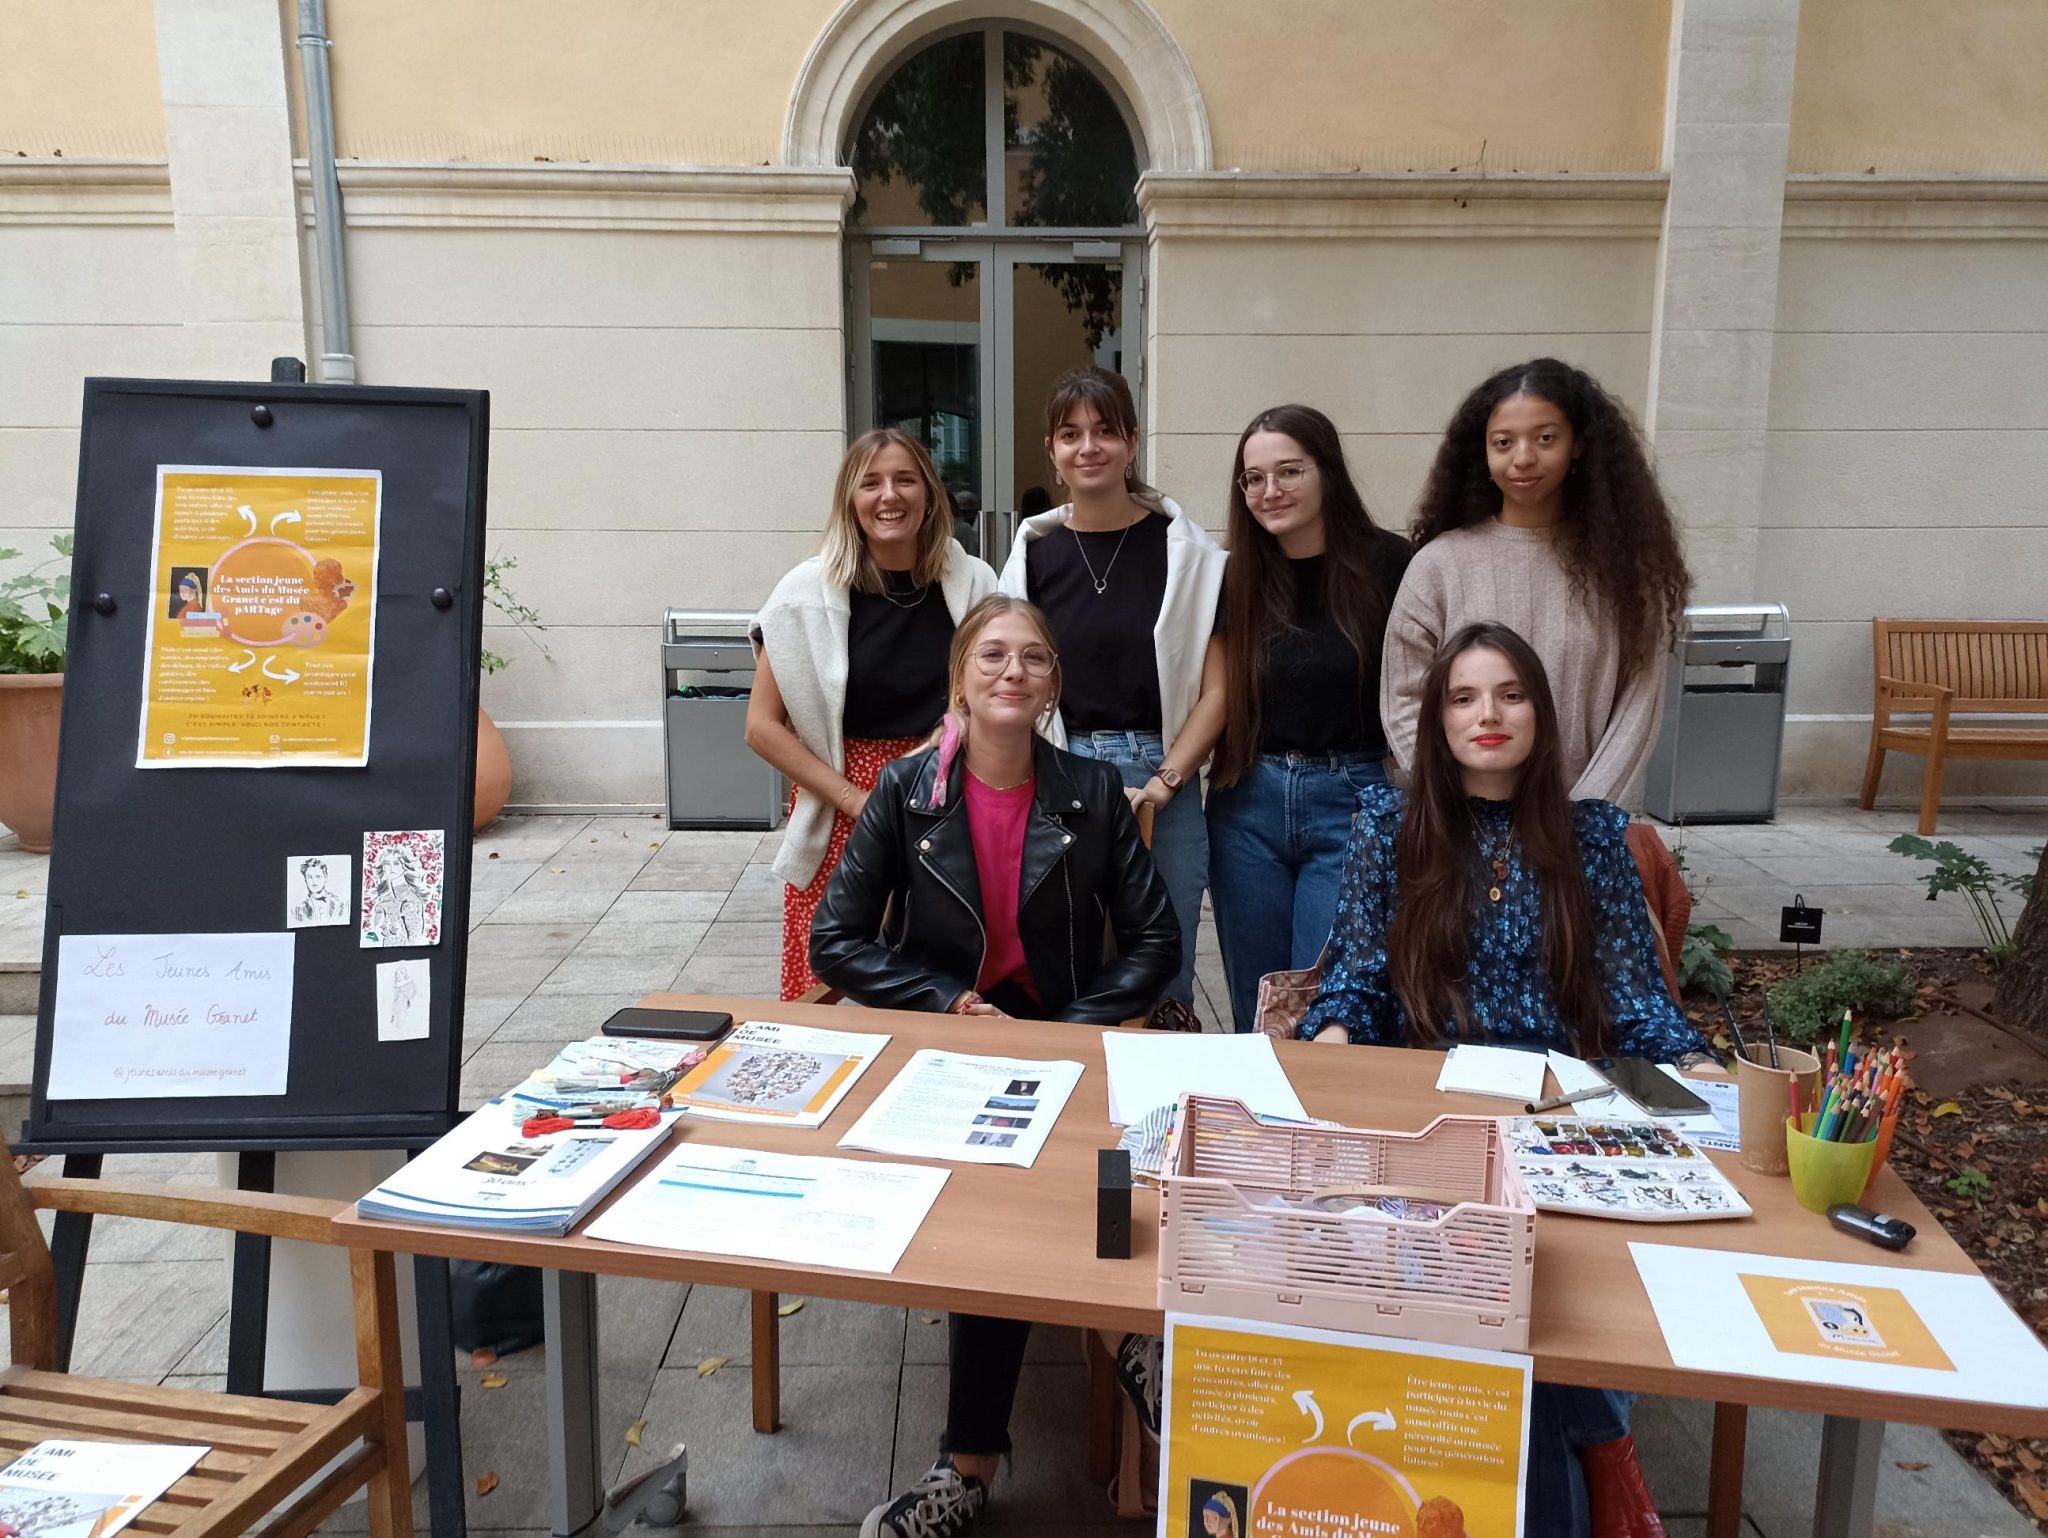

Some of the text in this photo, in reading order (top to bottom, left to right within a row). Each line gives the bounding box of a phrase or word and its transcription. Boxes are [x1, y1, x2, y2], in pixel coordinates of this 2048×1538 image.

[220, 575, 304, 586] La section jeune
[214, 585, 310, 594] des Amis du Musée
[222, 596, 300, 604] Granet c'est du
[234, 605, 282, 616] pARTage
[84, 943, 271, 980] Les Jeunes Amis
[104, 1004, 258, 1028] du Musée Granet
[1222, 1353, 1246, 1361] entre
[1274, 1370, 1291, 1379] des
[1248, 1380, 1268, 1389] aller
[1429, 1379, 1457, 1390] jeune
[1406, 1391, 1454, 1404] participer
[1494, 1401, 1507, 1411] du
[1192, 1399, 1238, 1411] participer
[1248, 1405, 1264, 1415] des
[1440, 1409, 1463, 1418] mais
[1235, 1418, 1259, 1428] avoir
[1405, 1418, 1479, 1434] aussi offrir une
[1404, 1444, 1426, 1452] pour
[1430, 1446, 1443, 1455] les
[1468, 1440, 1502, 1451] musée
[17, 1458, 43, 1466] DE
[1267, 1501, 1286, 1516] La
[1290, 1509, 1350, 1526] section
[1351, 1512, 1400, 1534] jeune
[1256, 1516, 1284, 1532] des
[1288, 1521, 1328, 1538] Amis
